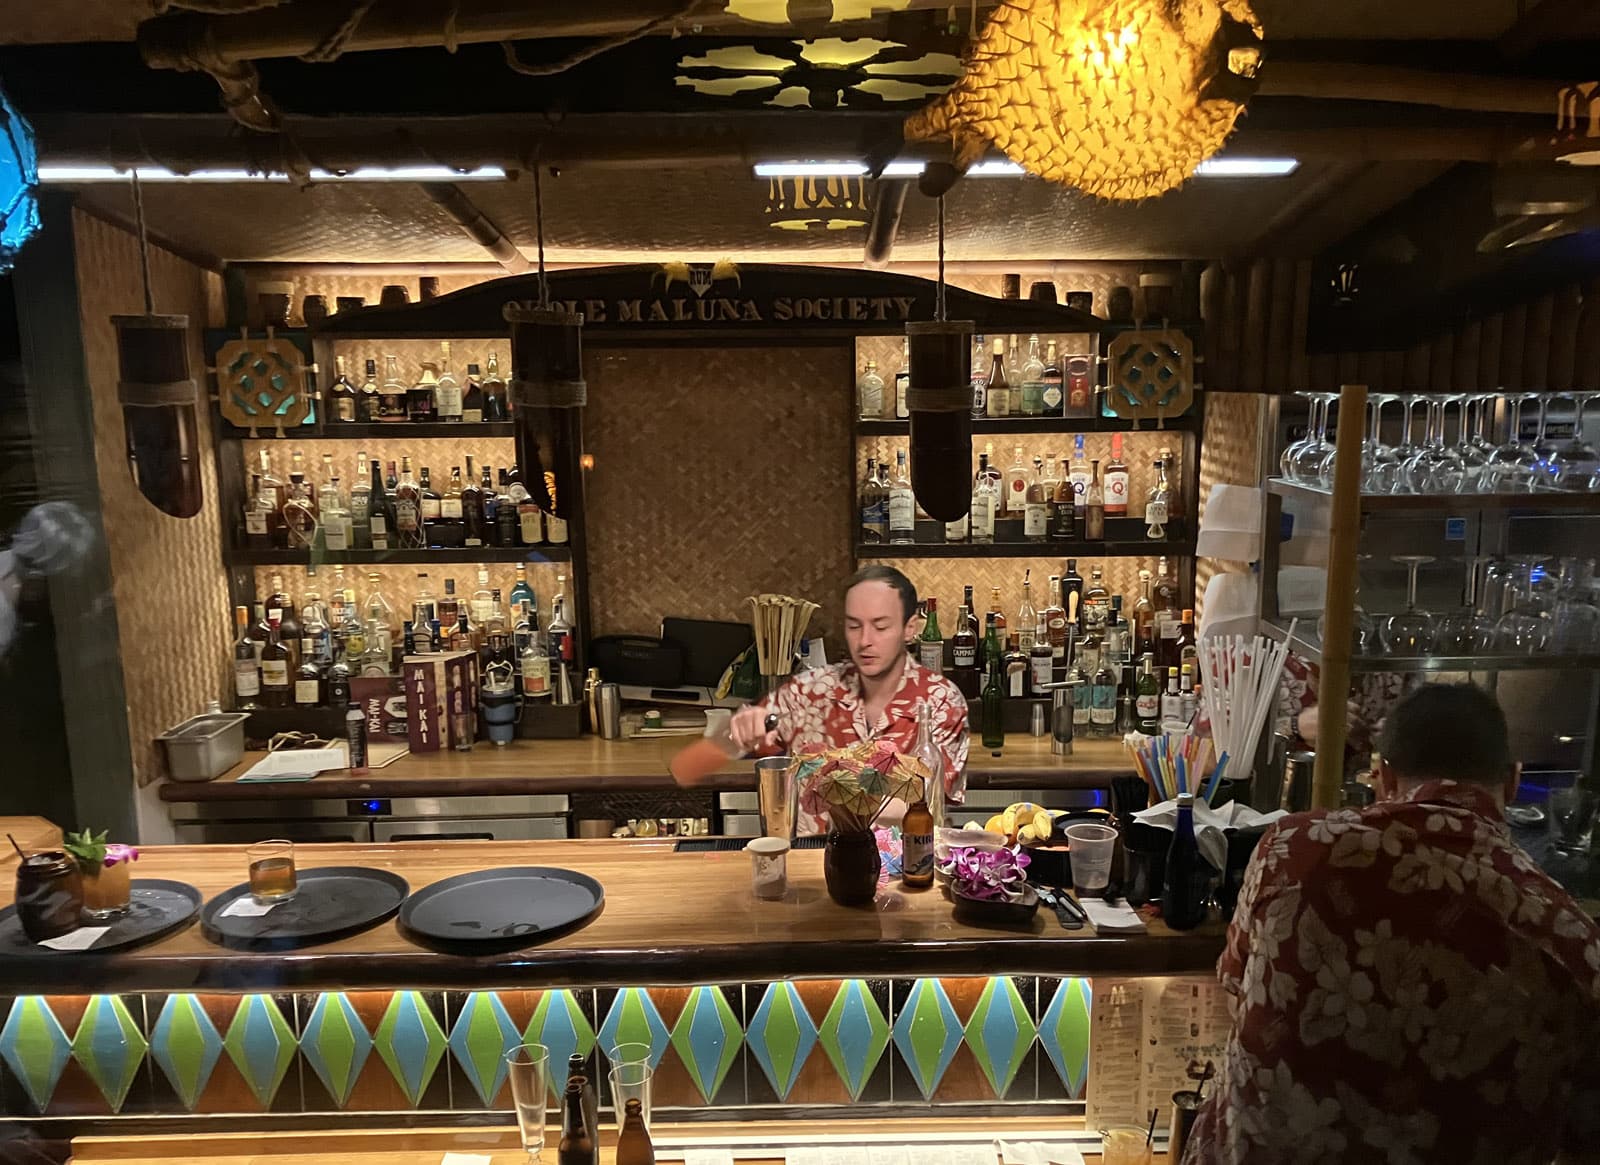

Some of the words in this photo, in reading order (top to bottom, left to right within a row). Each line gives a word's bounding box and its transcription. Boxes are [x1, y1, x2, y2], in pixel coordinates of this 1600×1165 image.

[689, 270, 712, 285] RUM
[618, 298, 762, 322] MALUNA
[773, 297, 917, 321] SOCIETY
[418, 708, 428, 744] KAI
